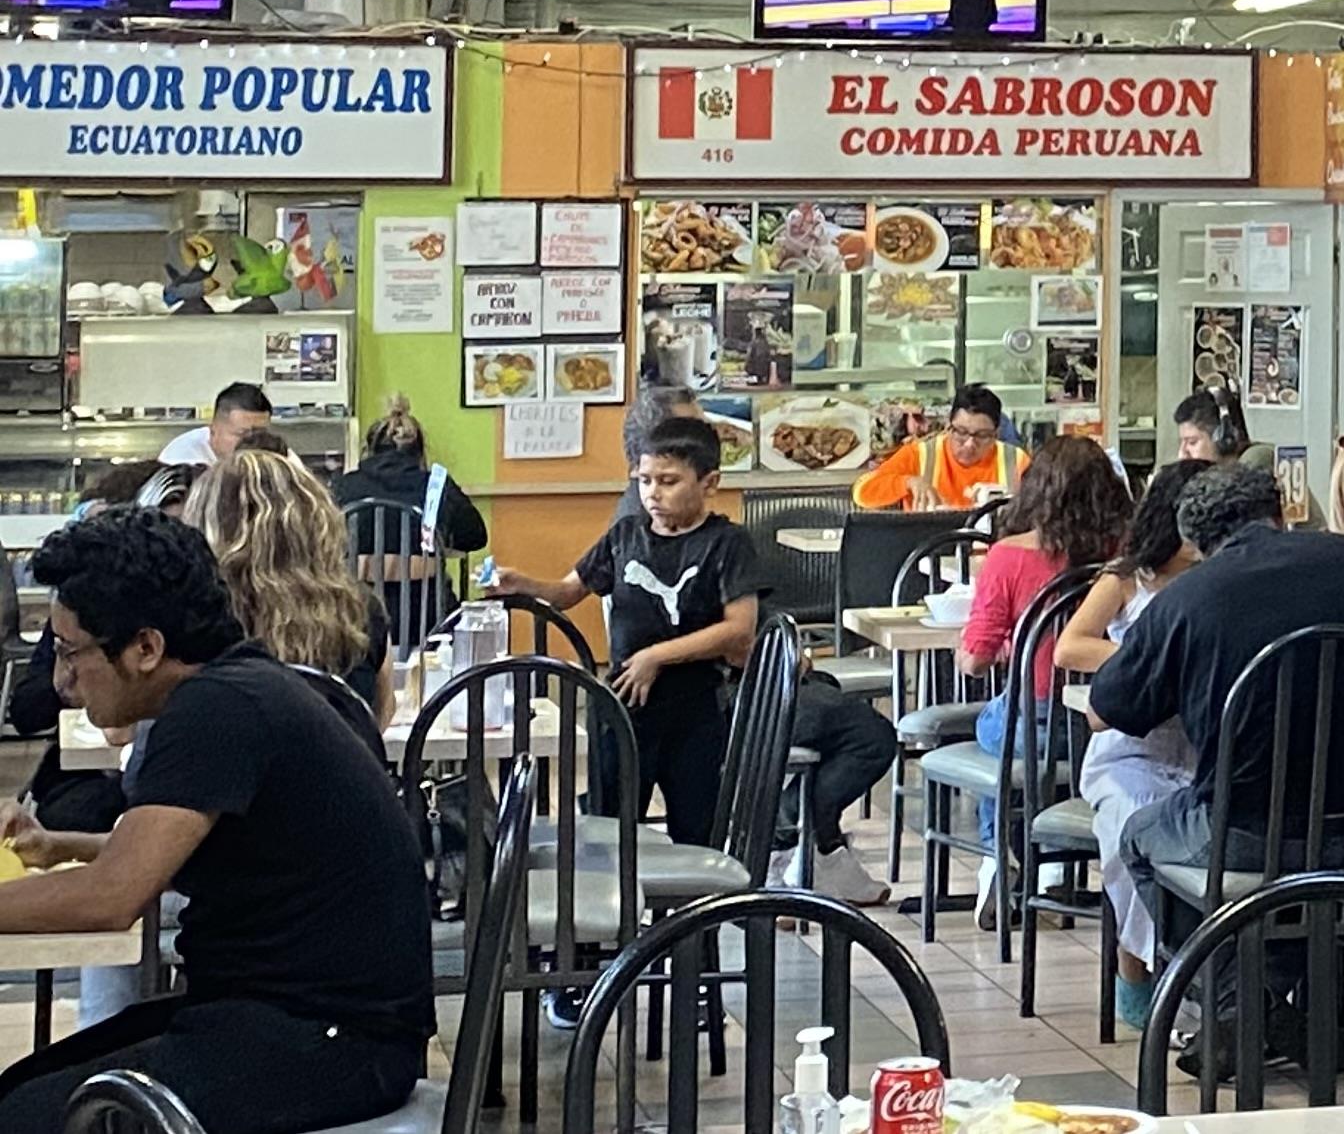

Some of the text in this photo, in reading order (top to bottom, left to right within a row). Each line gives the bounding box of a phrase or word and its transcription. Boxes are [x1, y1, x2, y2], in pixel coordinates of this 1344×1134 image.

[0, 63, 432, 113] MEDOR POPULAR
[827, 75, 1218, 117] EL SABROSON
[68, 125, 303, 156] ECUATORIANO
[701, 148, 734, 163] 416
[840, 127, 1203, 157] COMIDA PERUANA
[881, 1080, 938, 1122] Coca
